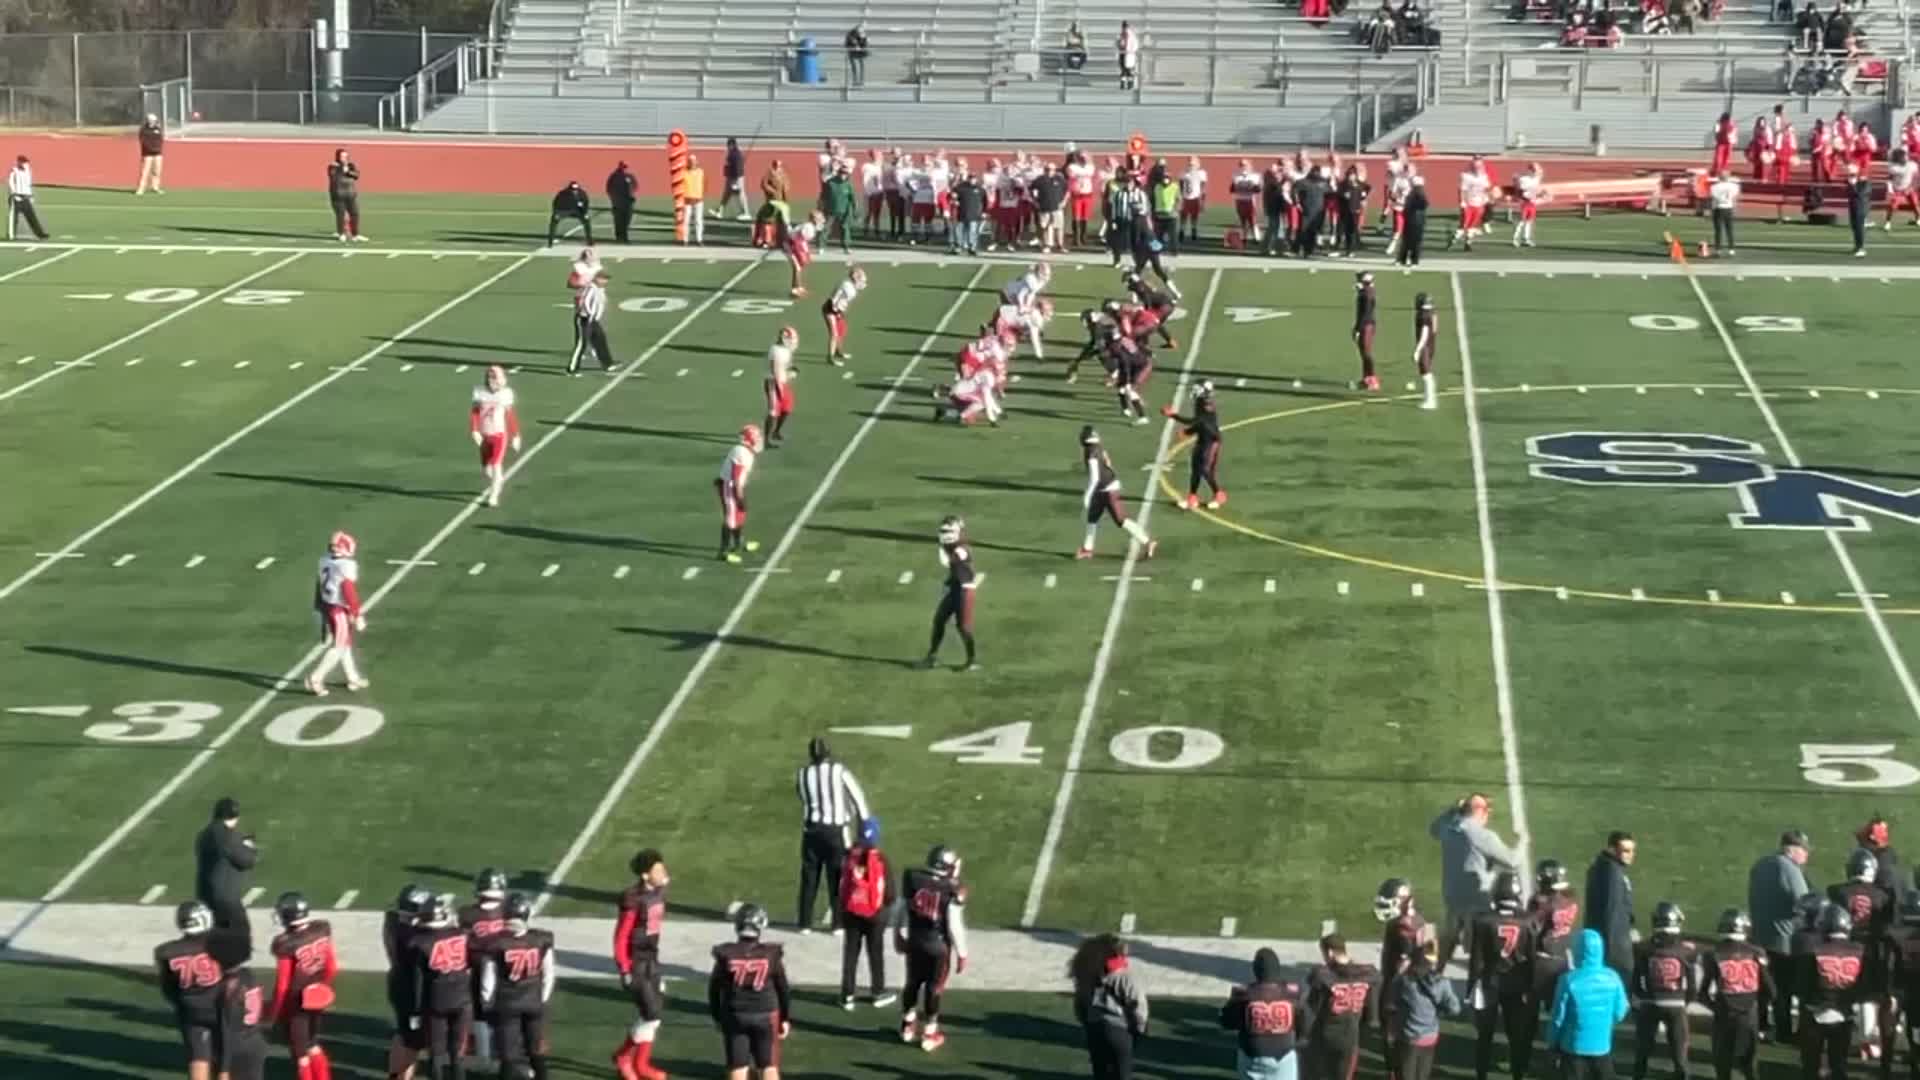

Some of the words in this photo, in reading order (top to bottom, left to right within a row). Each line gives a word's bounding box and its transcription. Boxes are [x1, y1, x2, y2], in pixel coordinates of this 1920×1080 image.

[83, 700, 386, 746] 30
[928, 721, 1226, 769] 40
[504, 947, 540, 982] 71
[729, 958, 769, 993] 77
